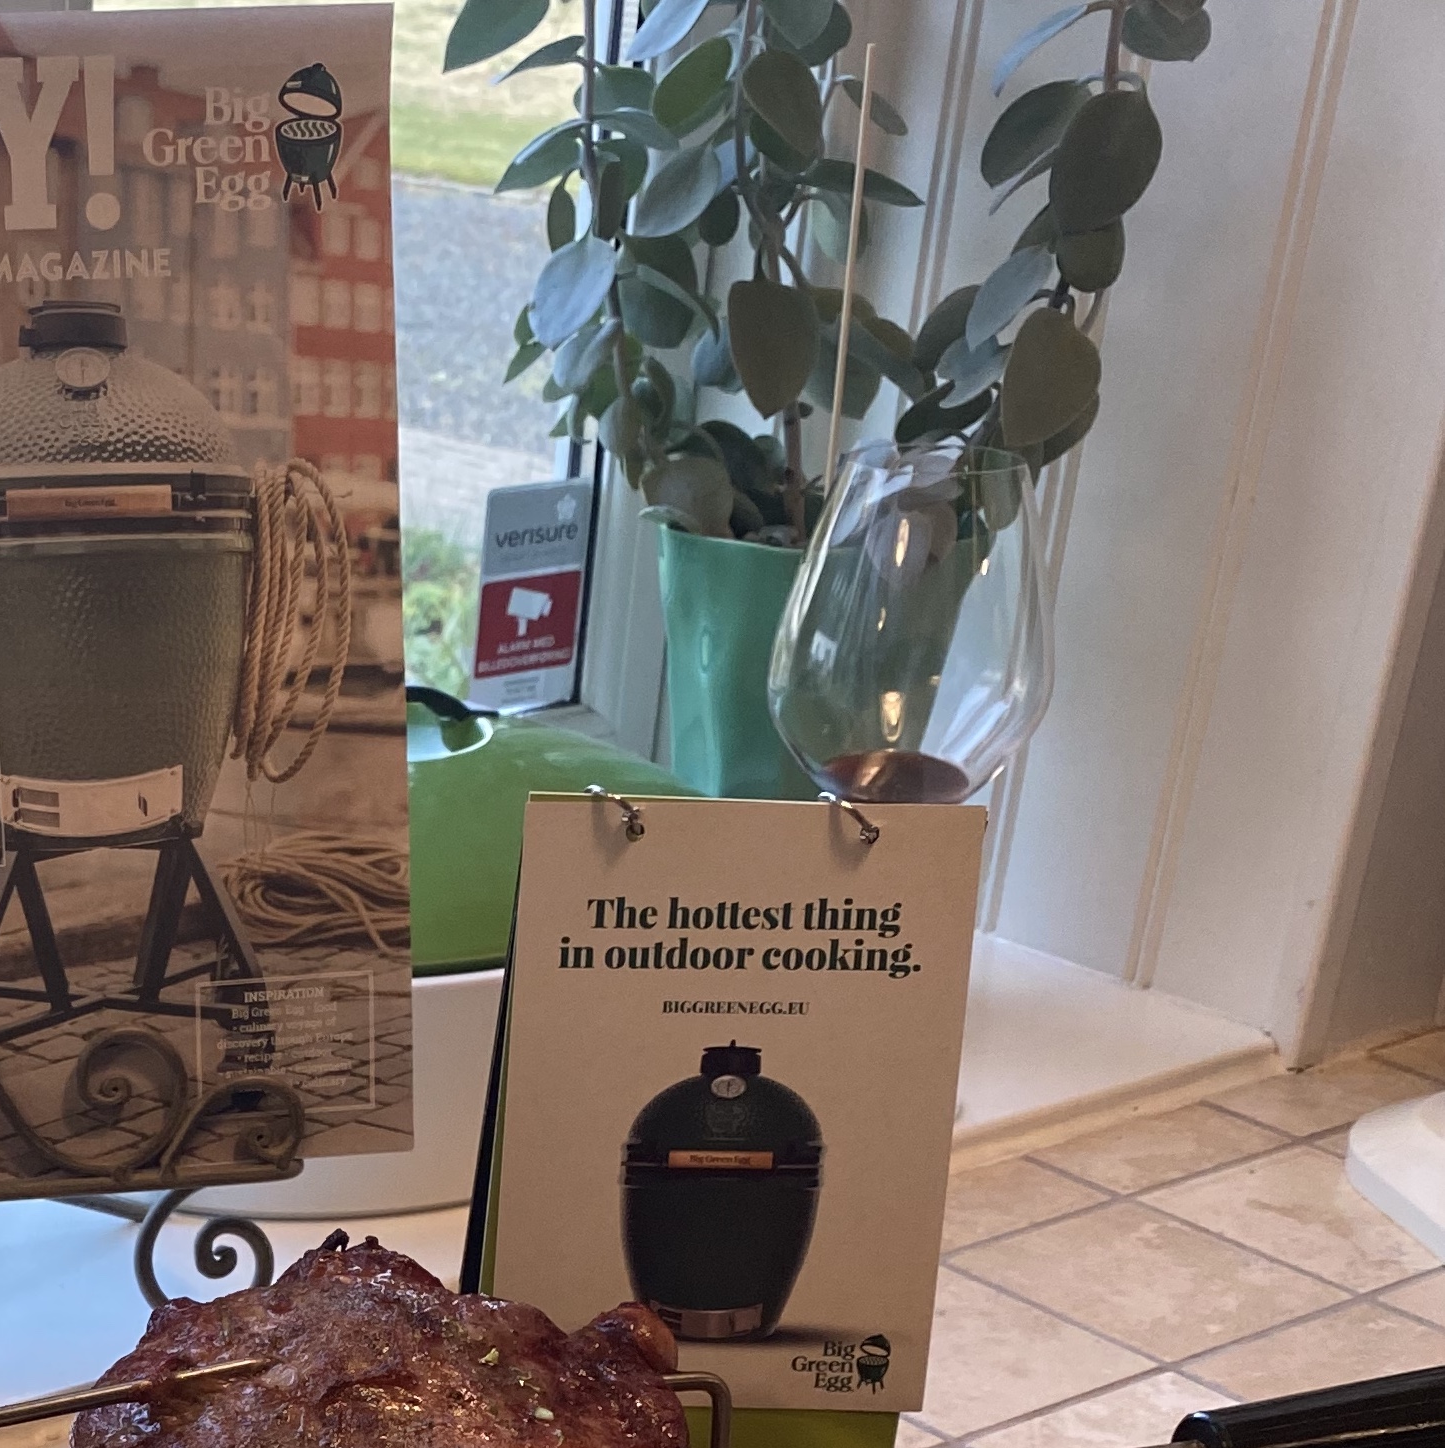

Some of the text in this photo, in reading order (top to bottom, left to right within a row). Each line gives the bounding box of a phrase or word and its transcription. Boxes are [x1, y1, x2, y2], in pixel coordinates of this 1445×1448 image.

[206, 86, 271, 133] Big
[142, 128, 272, 167] Green
[195, 166, 273, 212] Egg
[495, 522, 579, 548] verisure
[587, 897, 901, 939] The hottest thing
[557, 936, 922, 979] in outdoor cooking.
[244, 987, 325, 1003] INSPIRATION
[661, 1000, 810, 1017] BIGGREENEGG.EU
[217, 1037, 269, 1050] discovery
[823, 1340, 855, 1360] Big
[791, 1355, 853, 1373] Green
[814, 1372, 854, 1392] Egg
